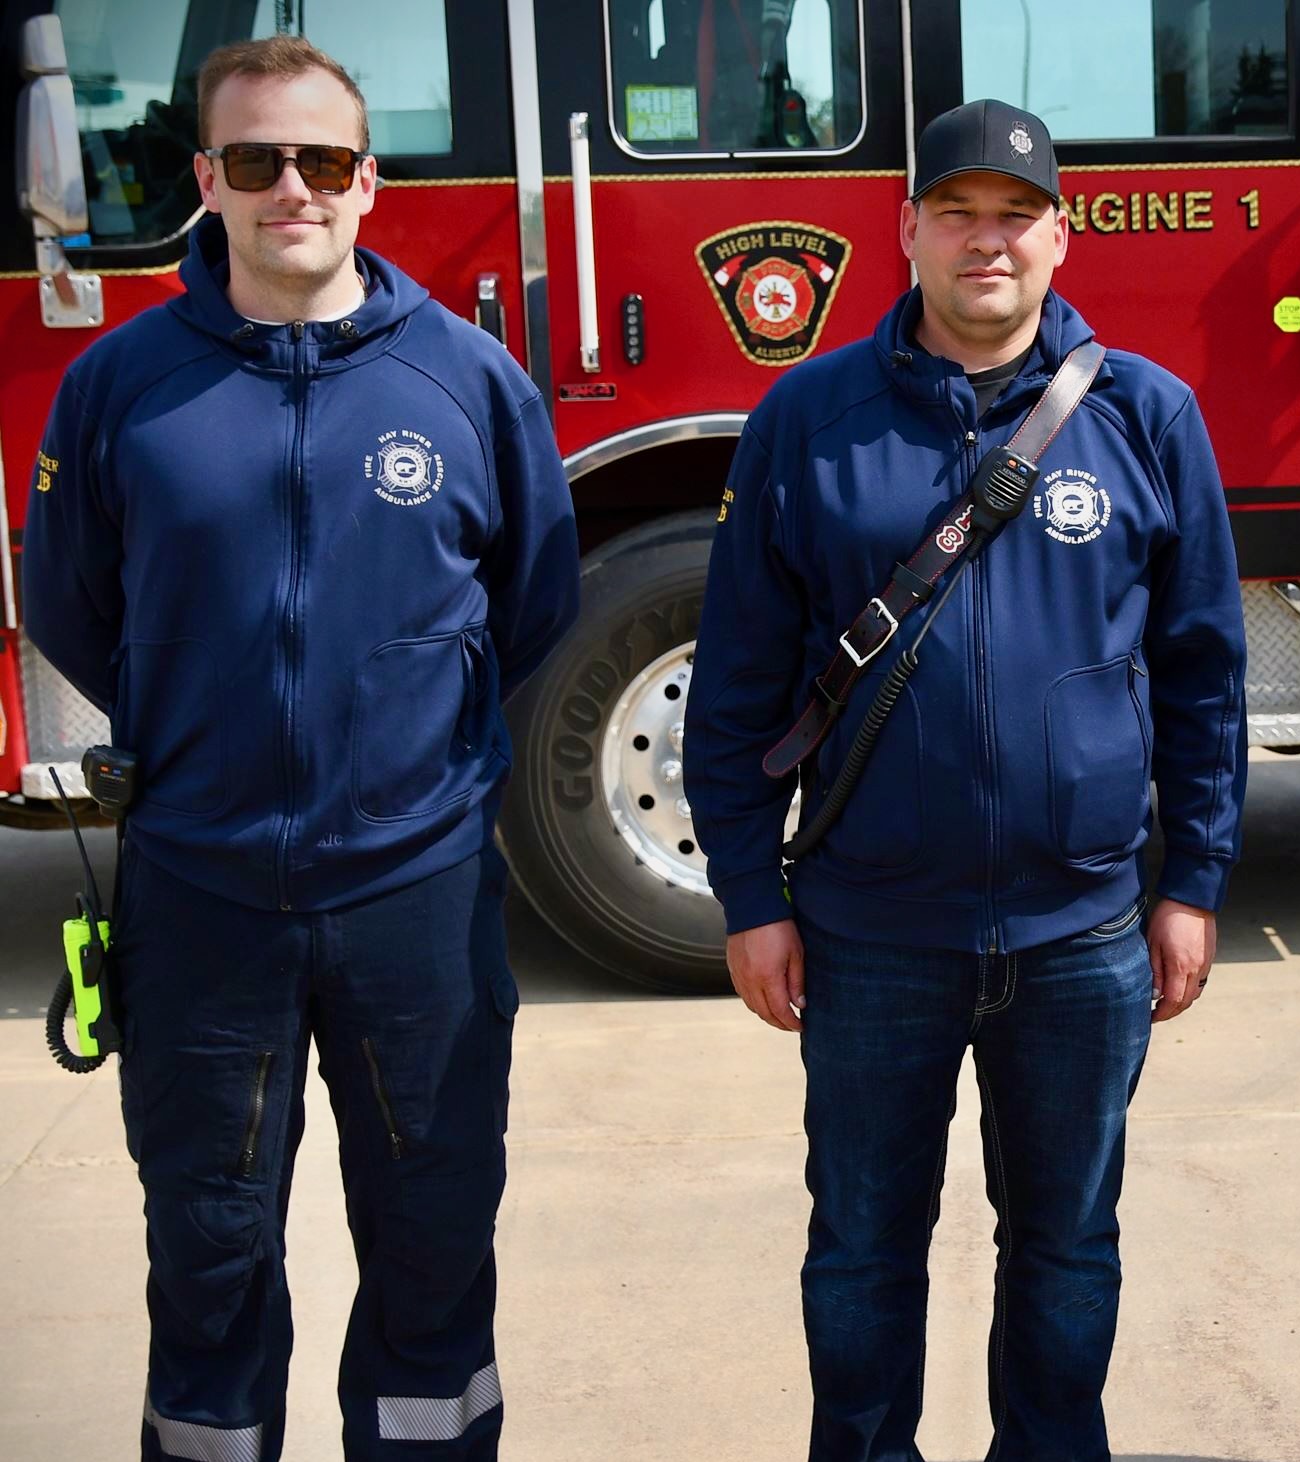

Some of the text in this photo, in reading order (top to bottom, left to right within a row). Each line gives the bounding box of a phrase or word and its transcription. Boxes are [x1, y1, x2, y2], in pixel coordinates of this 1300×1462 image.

[1059, 188, 1261, 233] NGINE 1
[715, 232, 828, 260] HIGH LEVEL
[754, 345, 804, 359] ALBERTA
[378, 429, 432, 449] HAY RIVER
[364, 455, 373, 478] FIRE
[432, 453, 444, 492] RESCUE
[1002, 467, 1026, 484] KENWOOD
[1043, 468, 1097, 485] HAY RIVER
[373, 487, 433, 506] AMBULANCE
[1033, 495, 1043, 518] FIRE
[1098, 488, 1112, 527] RESCUE
[1044, 526, 1102, 545] AMBULANCE
